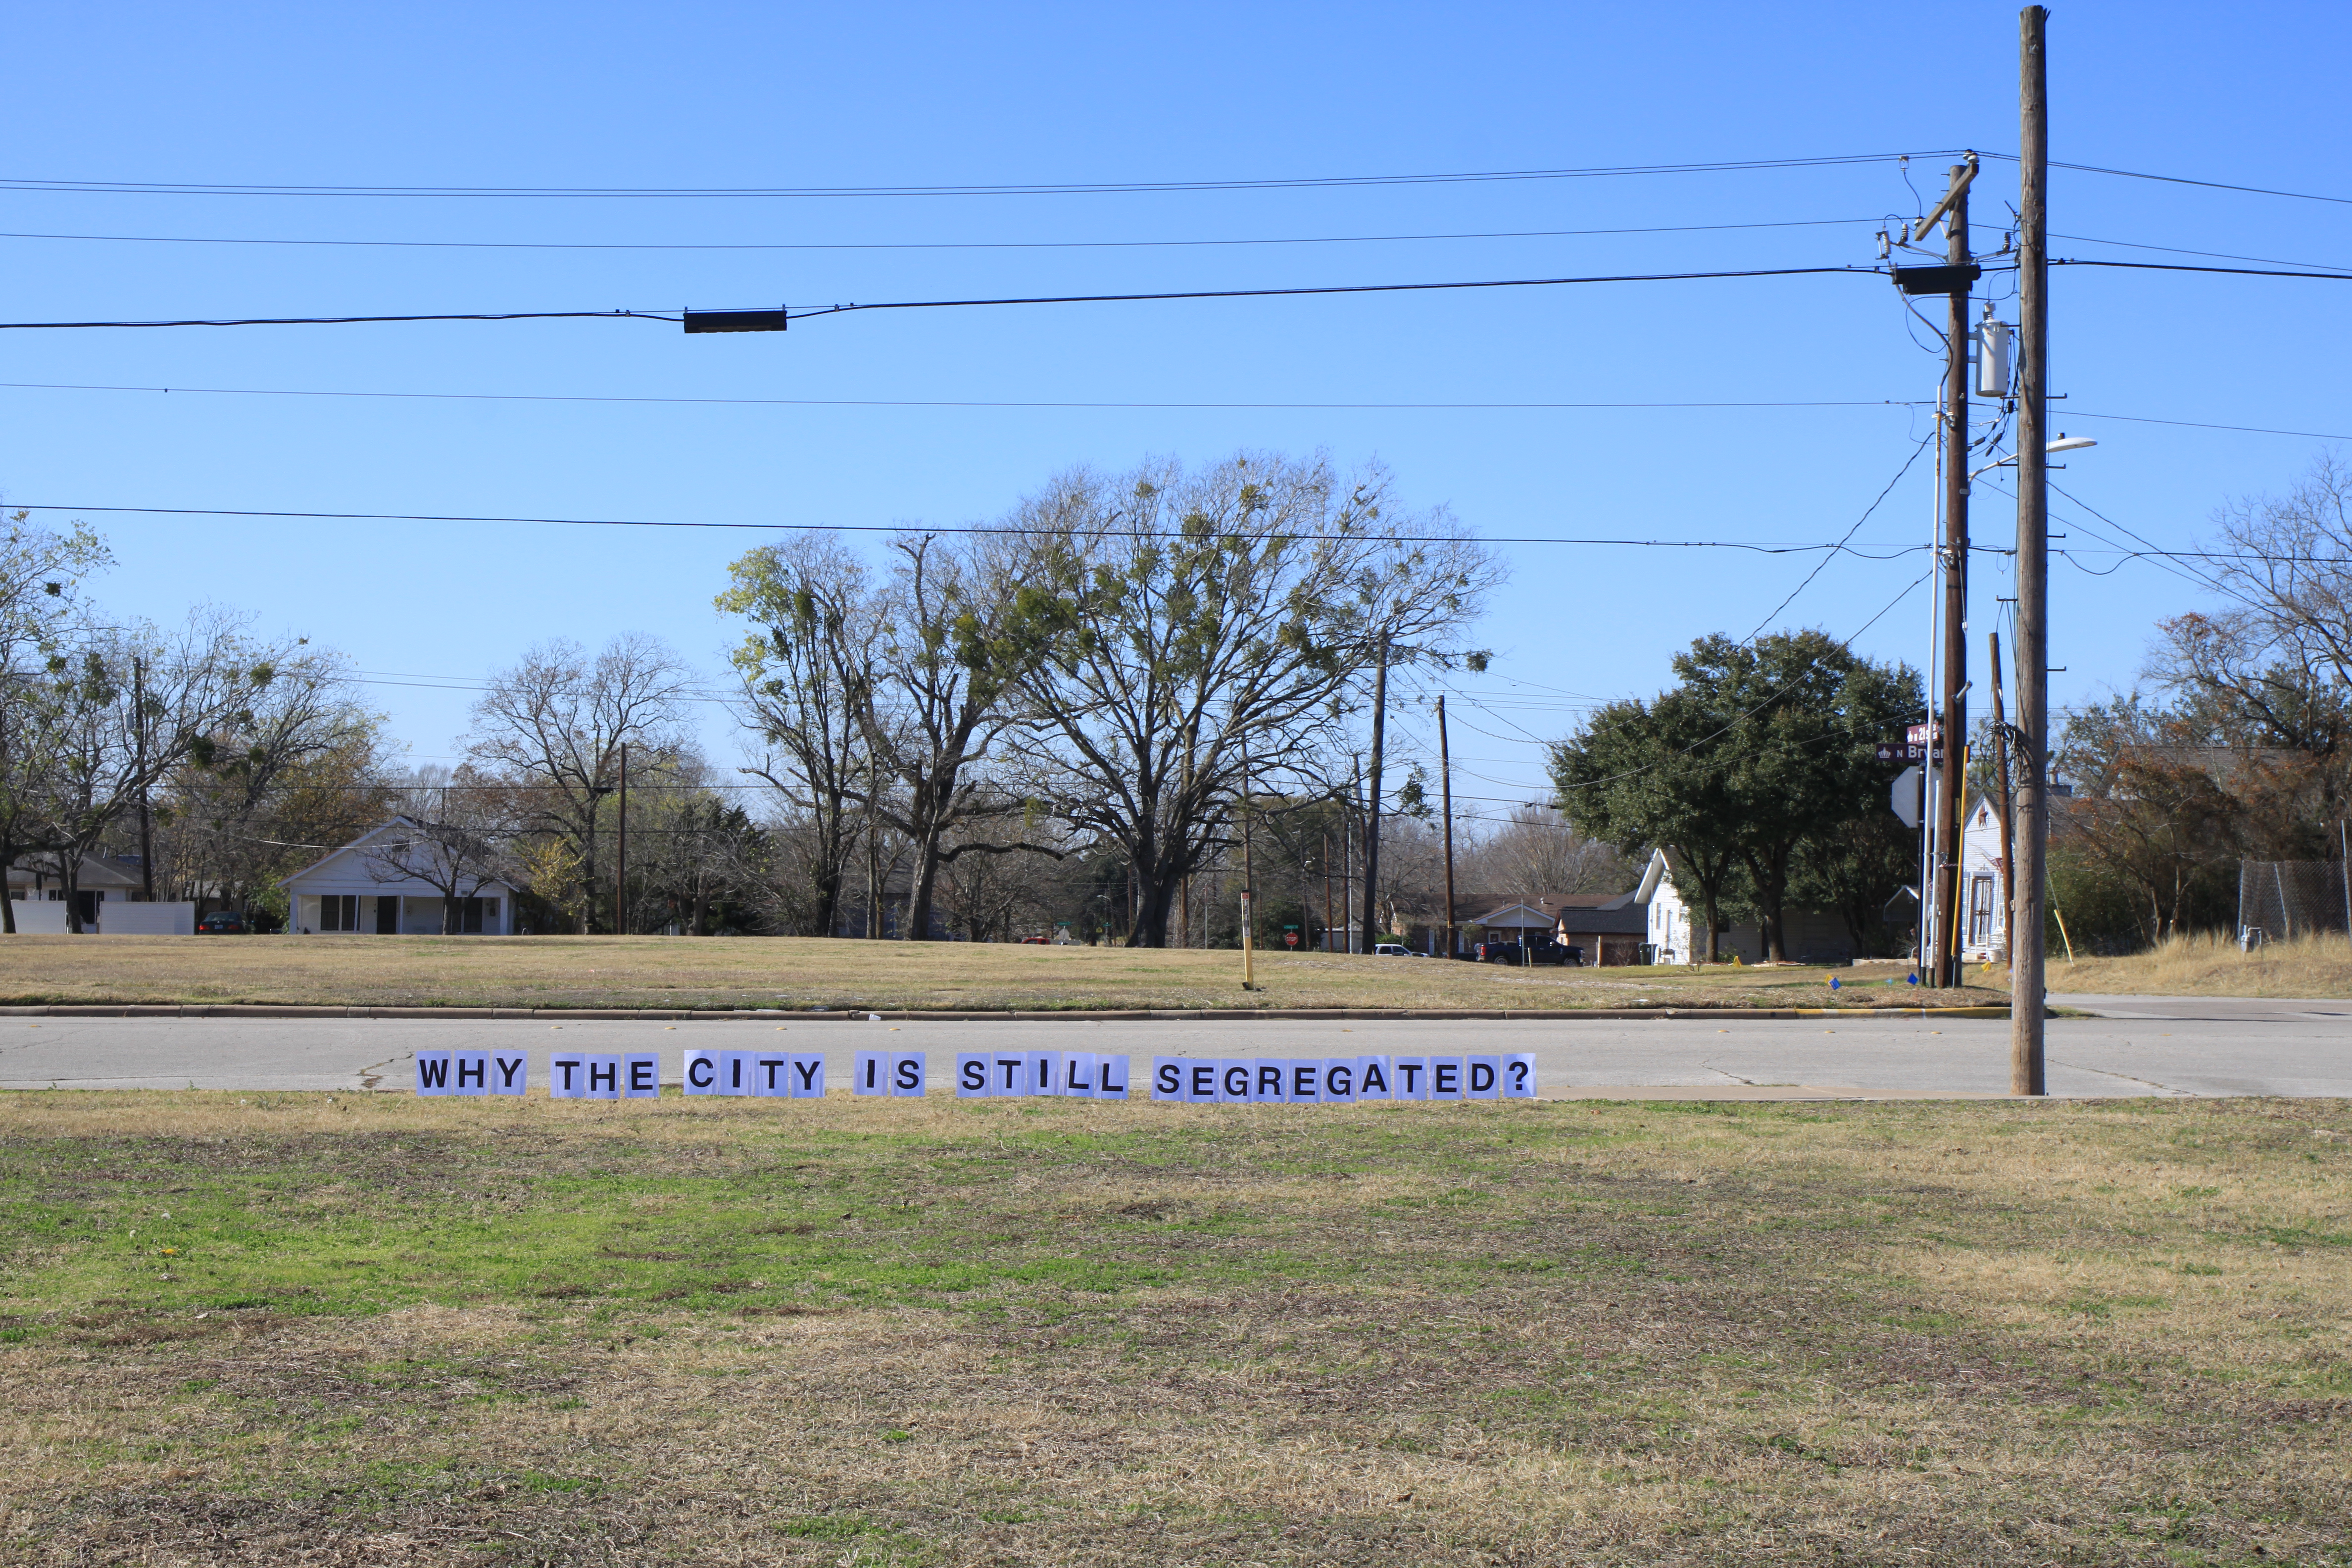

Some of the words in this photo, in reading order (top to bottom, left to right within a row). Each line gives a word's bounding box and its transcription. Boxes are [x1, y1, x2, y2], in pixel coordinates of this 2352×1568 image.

[1897, 749, 1903, 758] N
[419, 1058, 523, 1088] WHY
[555, 1061, 653, 1091] THE
[689, 1058, 820, 1090] CITY
[867, 1059, 919, 1089] IS
[962, 1059, 1123, 1092] STILL
[1157, 1061, 1528, 1096] SEGREGATED?
